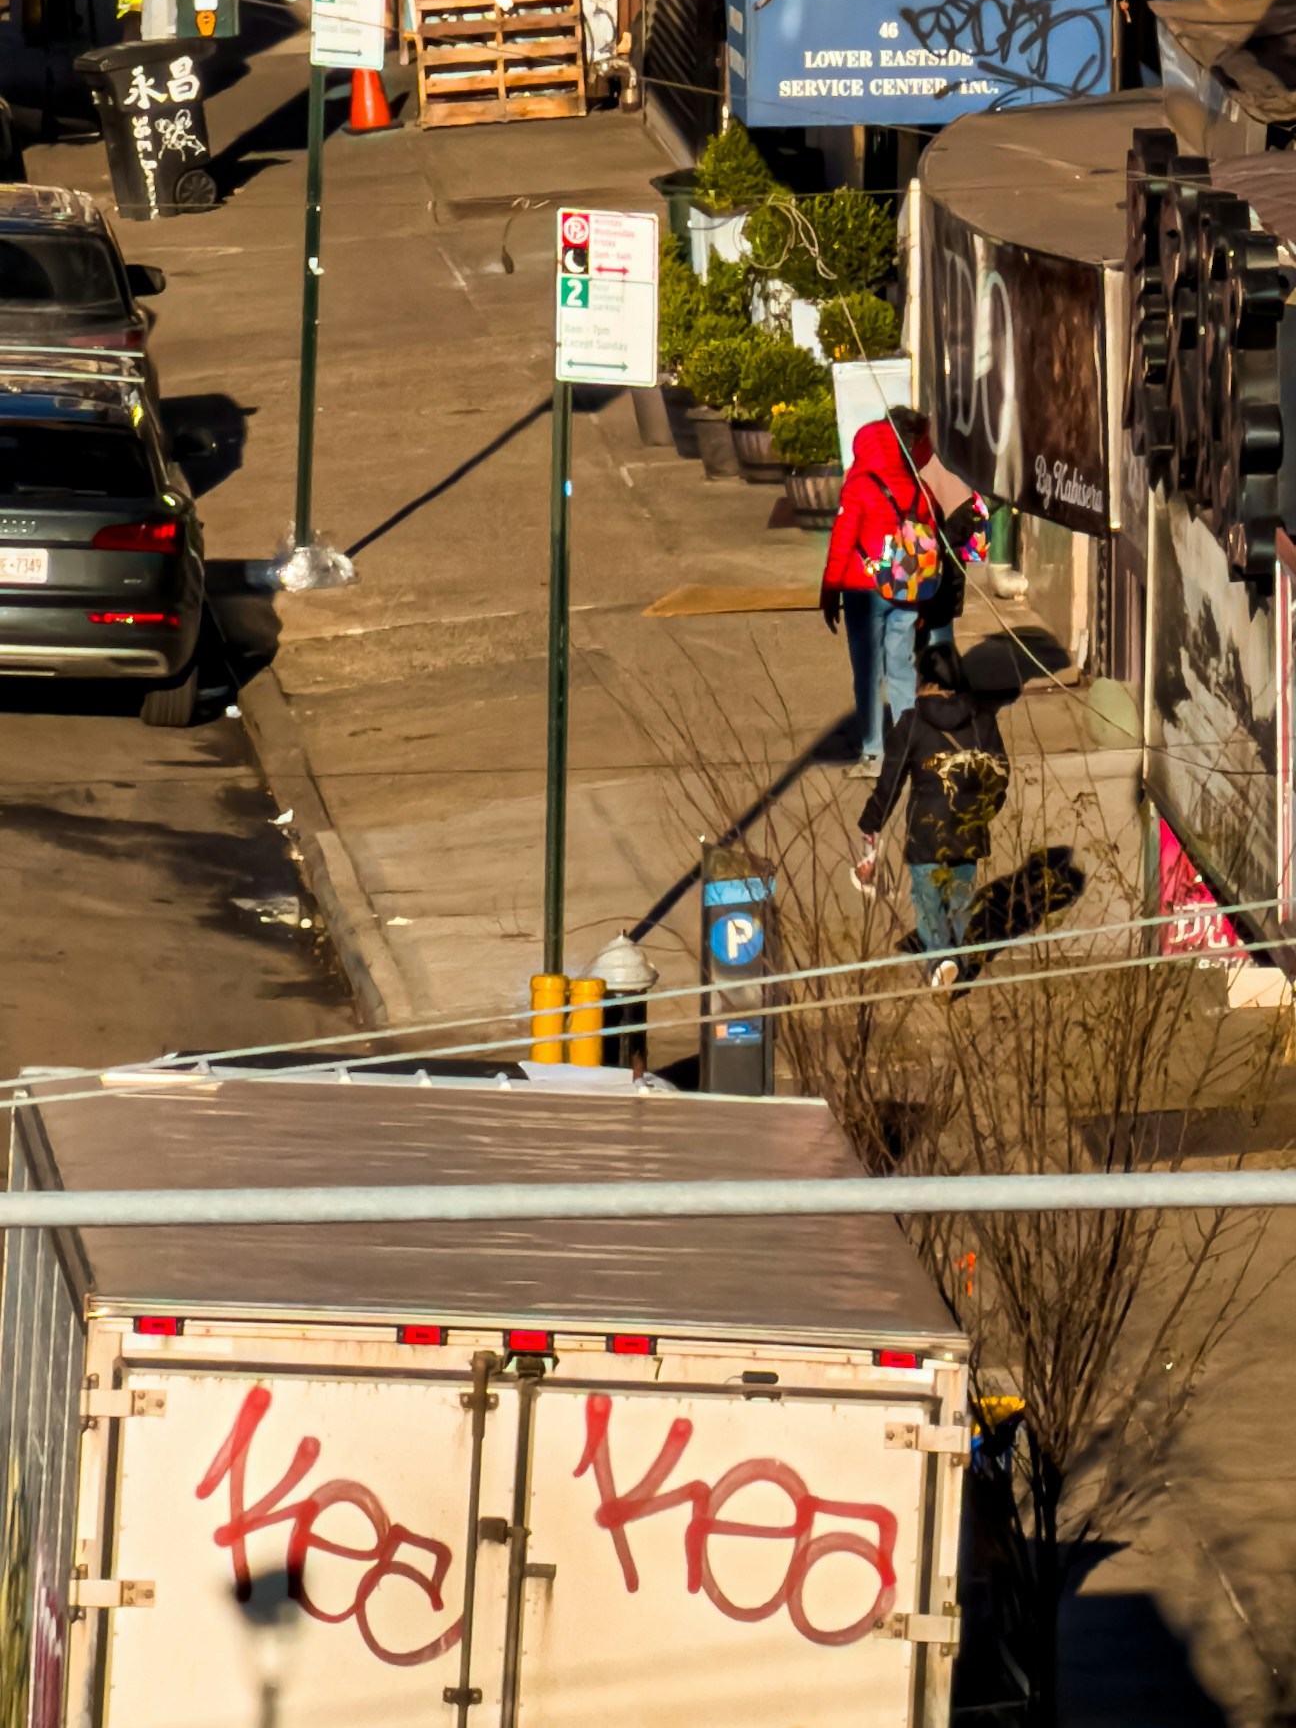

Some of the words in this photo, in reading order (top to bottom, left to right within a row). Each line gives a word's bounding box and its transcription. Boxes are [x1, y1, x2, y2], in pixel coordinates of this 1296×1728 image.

[879, 22, 898, 38] 46
[804, 49, 873, 69] LOWER
[880, 48, 974, 67] EASTSIDE
[123, 56, 200, 109] 永昌
[779, 79, 864, 98] SERVICE
[566, 279, 583, 307] 2
[727, 918, 753, 960] P
